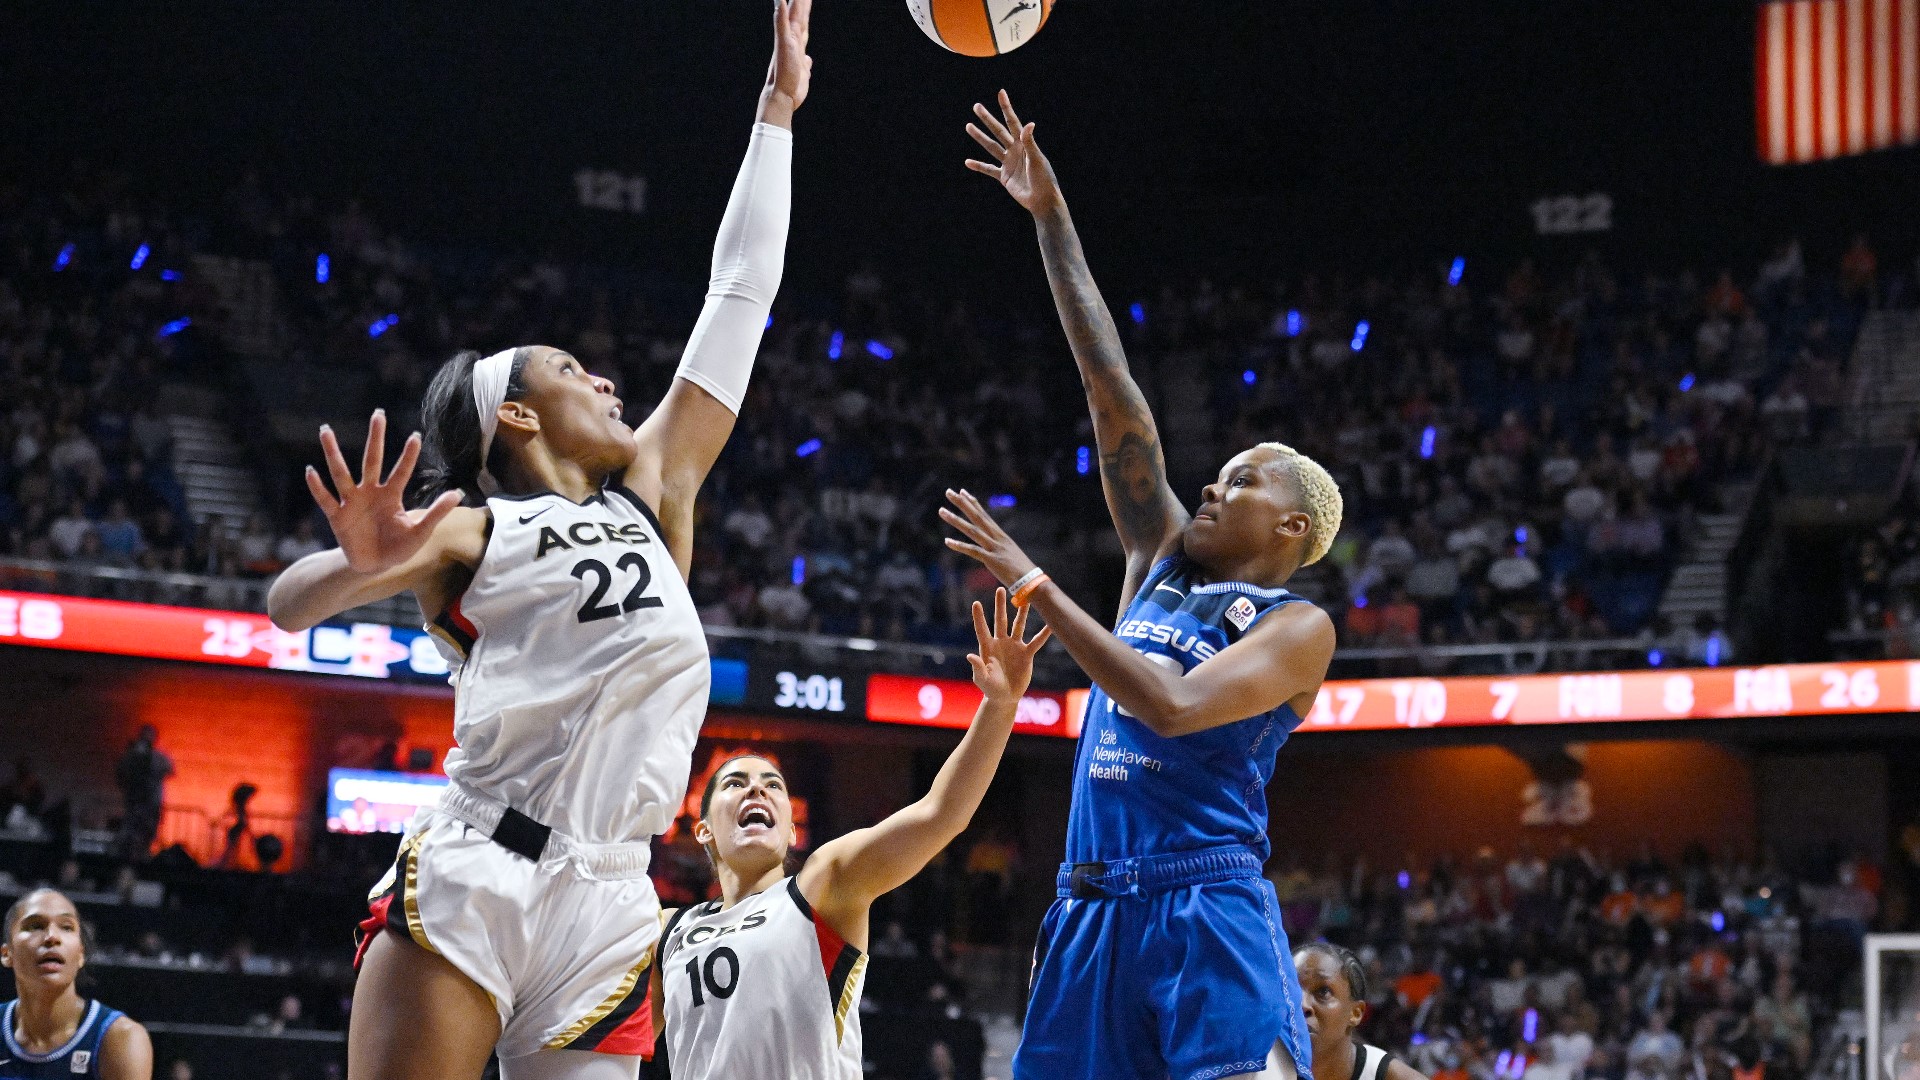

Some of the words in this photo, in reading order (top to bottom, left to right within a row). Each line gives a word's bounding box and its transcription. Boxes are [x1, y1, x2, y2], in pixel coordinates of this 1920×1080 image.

[574, 169, 646, 212] 121
[1531, 193, 1613, 233] 122
[535, 521, 651, 561] ACES
[570, 552, 665, 623] 22
[202, 618, 253, 658] 25
[775, 671, 846, 712] 3:01
[917, 684, 943, 719] 9
[1014, 697, 1060, 726] ND
[1391, 680, 1447, 727] T/O
[1489, 682, 1519, 720] 7
[1663, 674, 1695, 714] 8
[1820, 668, 1880, 708] 26
[1099, 729, 1117, 745] Yale
[1089, 763, 1129, 781] Health
[1093, 746, 1163, 772] NewHaven
[685, 946, 740, 1008] 10
